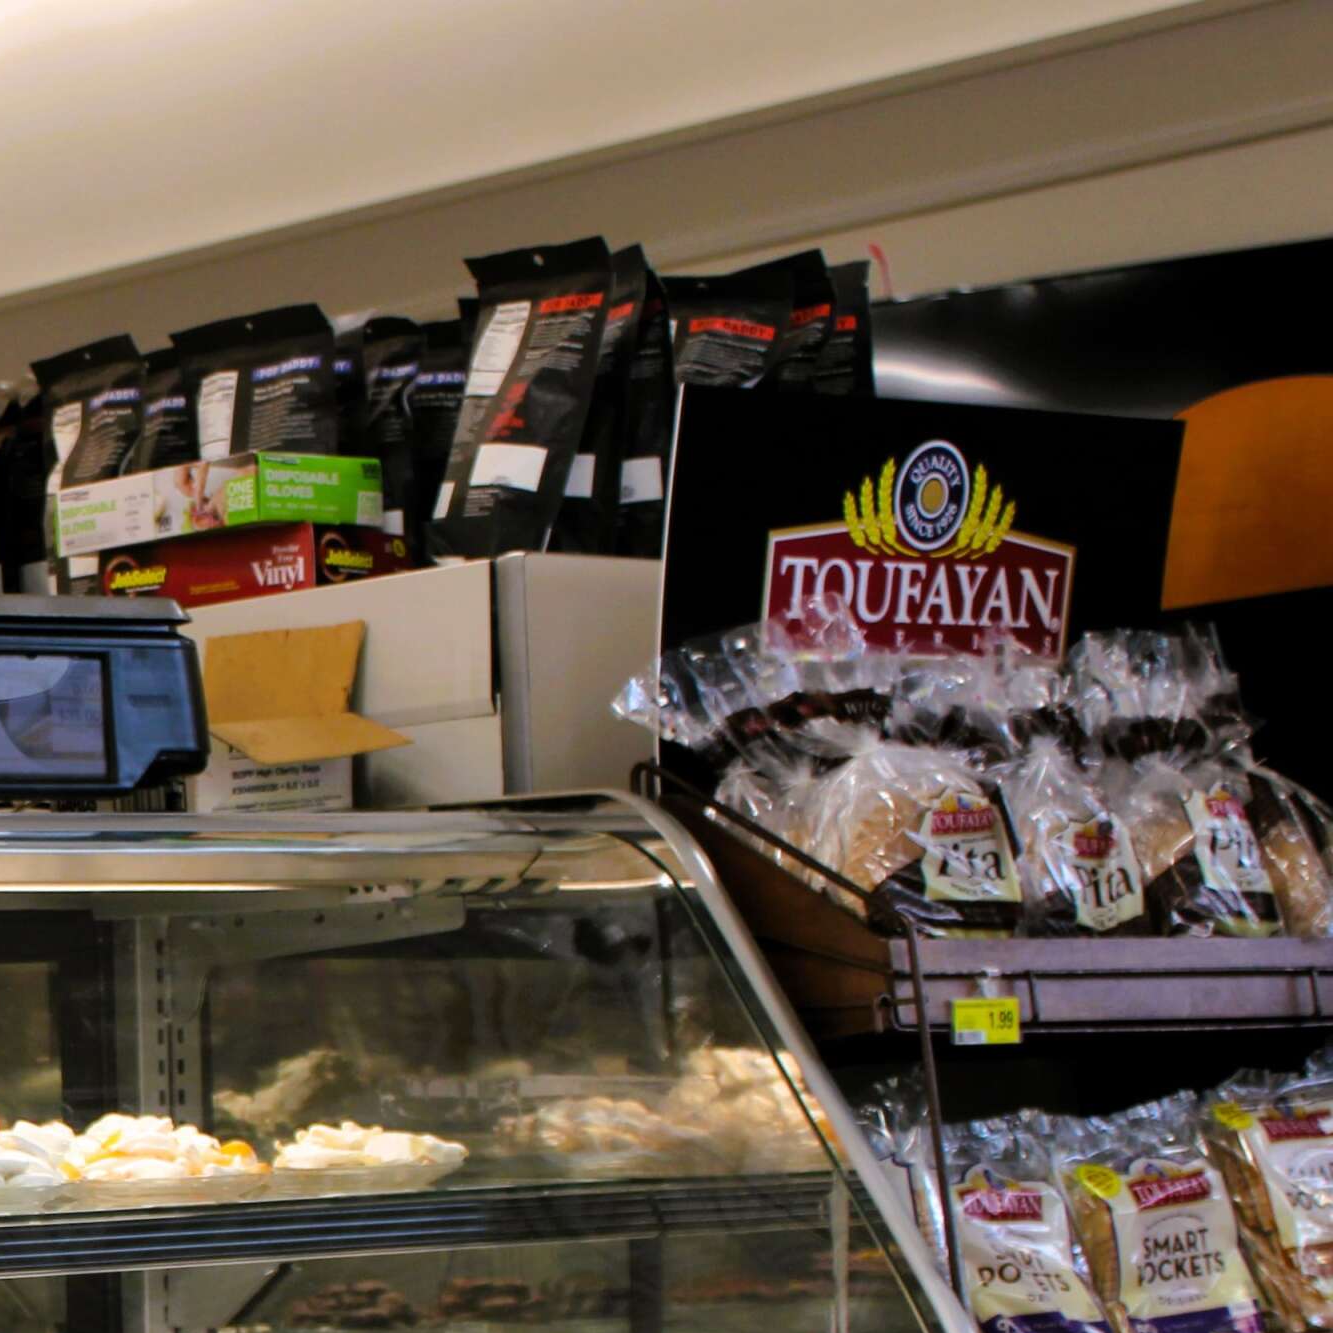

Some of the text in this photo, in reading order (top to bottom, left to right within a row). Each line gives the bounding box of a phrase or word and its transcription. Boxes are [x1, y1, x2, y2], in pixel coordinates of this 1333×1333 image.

[910, 455, 961, 487] QUALITY
[227, 478, 254, 496] ONE
[266, 483, 314, 499] GLOVES
[228, 494, 254, 512] SIZE
[905, 503, 934, 538] SINCE
[250, 555, 306, 590] Vinyl
[779, 556, 1060, 629] TOUFAYAN
[988, 1011, 1014, 1030] 1.99
[1142, 1228, 1210, 1259] SMART
